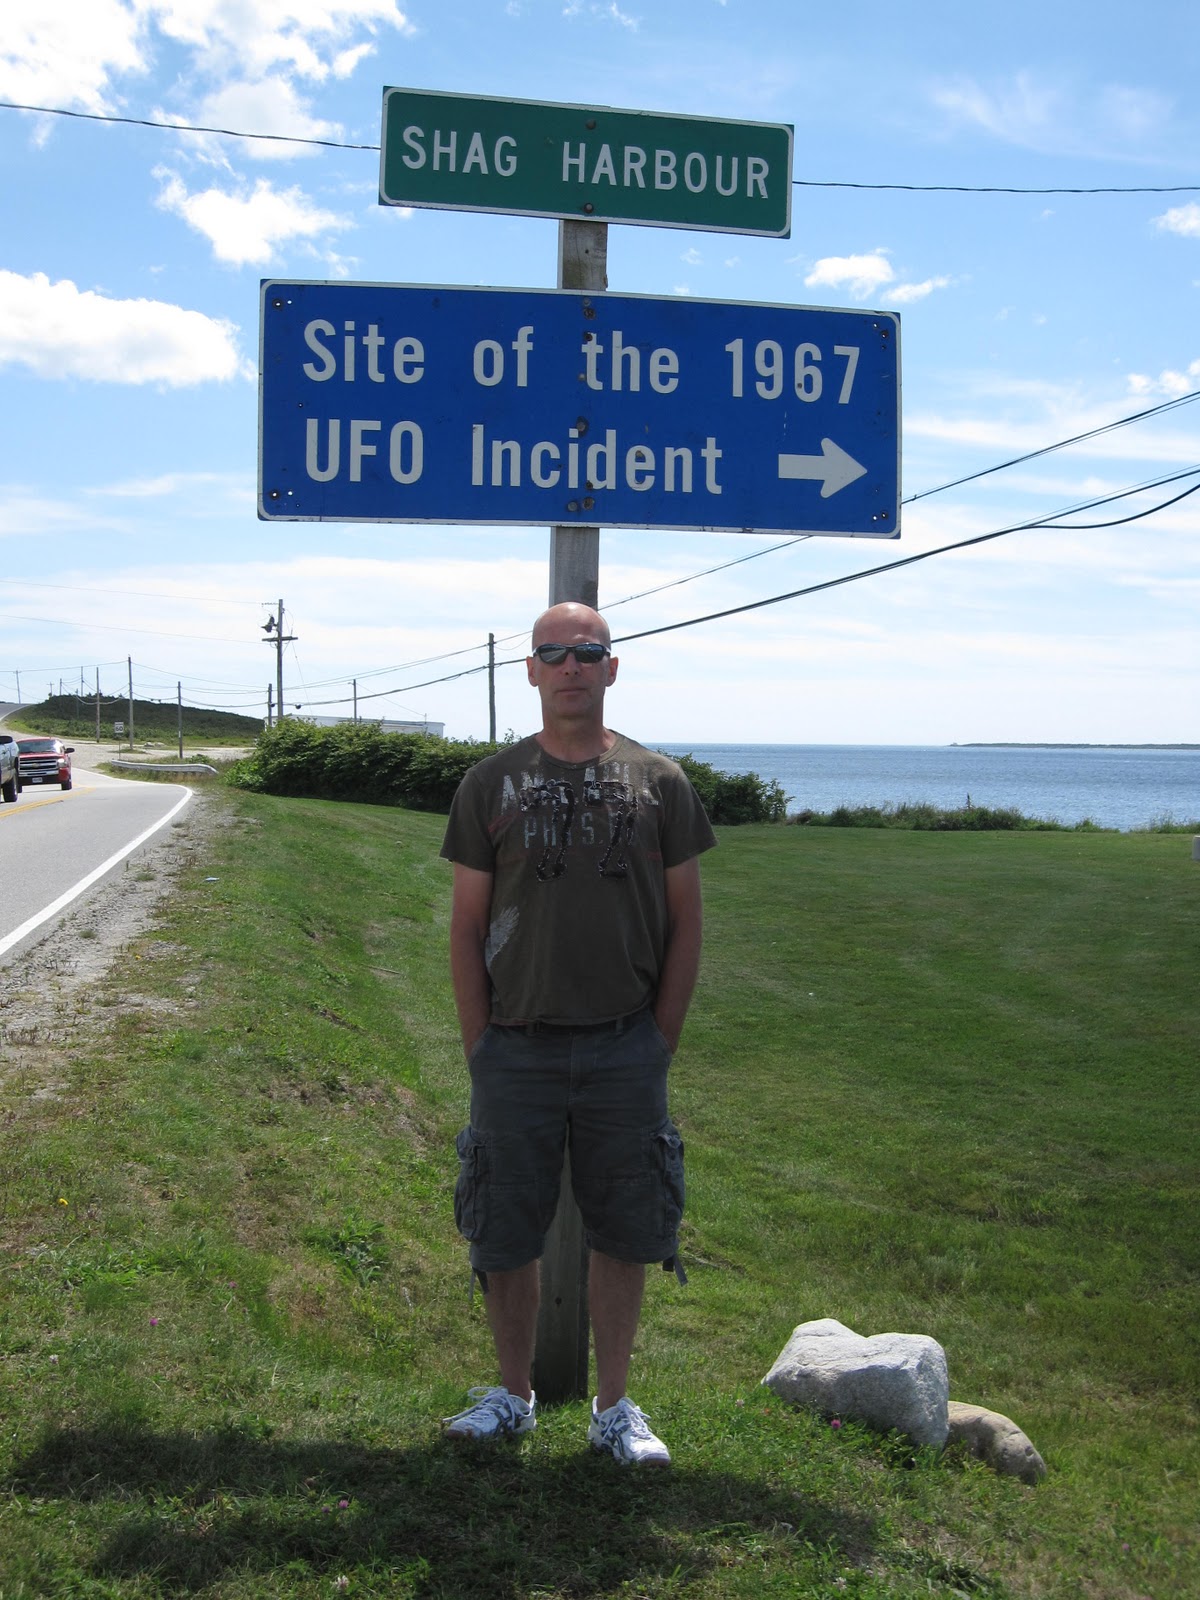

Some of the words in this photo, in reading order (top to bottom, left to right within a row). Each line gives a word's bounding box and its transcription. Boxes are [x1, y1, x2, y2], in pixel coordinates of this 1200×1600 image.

[401, 124, 518, 178] SHAG
[562, 142, 770, 199] HARBOUR
[303, 319, 425, 384] Site
[473, 325, 534, 388] of
[581, 330, 680, 395] the
[725, 337, 861, 405] 1967
[305, 418, 424, 485] UFO
[471, 424, 723, 495] Incident
